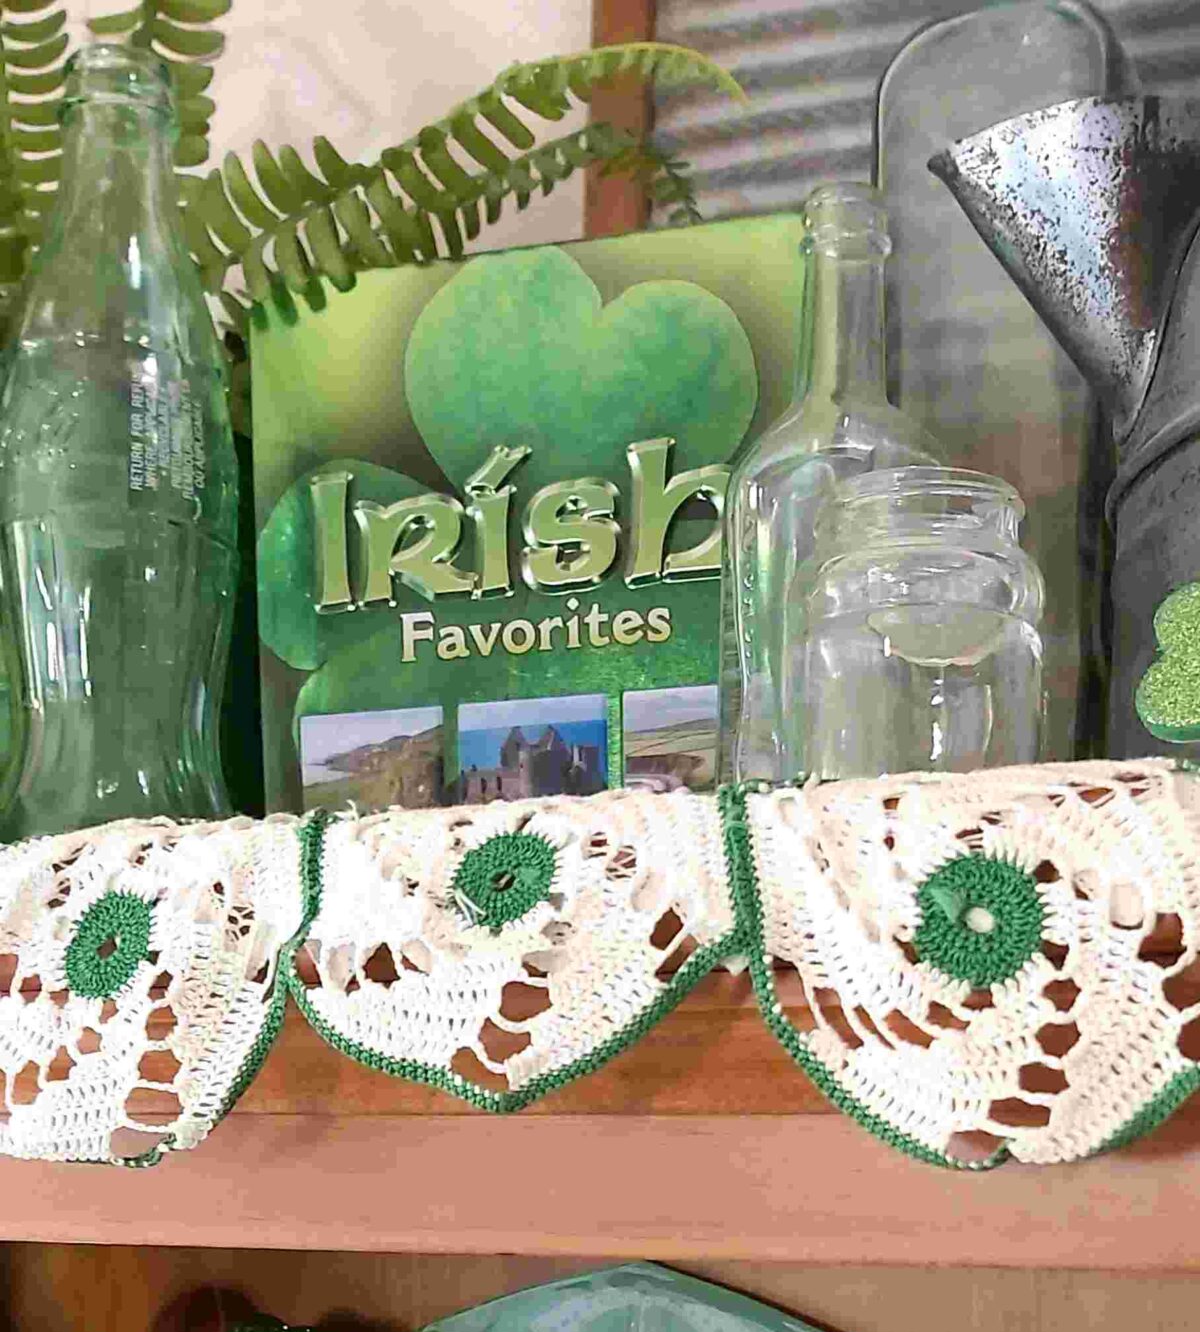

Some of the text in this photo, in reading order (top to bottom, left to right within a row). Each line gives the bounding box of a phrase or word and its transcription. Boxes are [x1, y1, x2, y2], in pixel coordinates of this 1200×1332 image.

[130, 413, 143, 437] FOR
[130, 443, 143, 490] RETURN
[400, 598, 673, 663] Favorites
